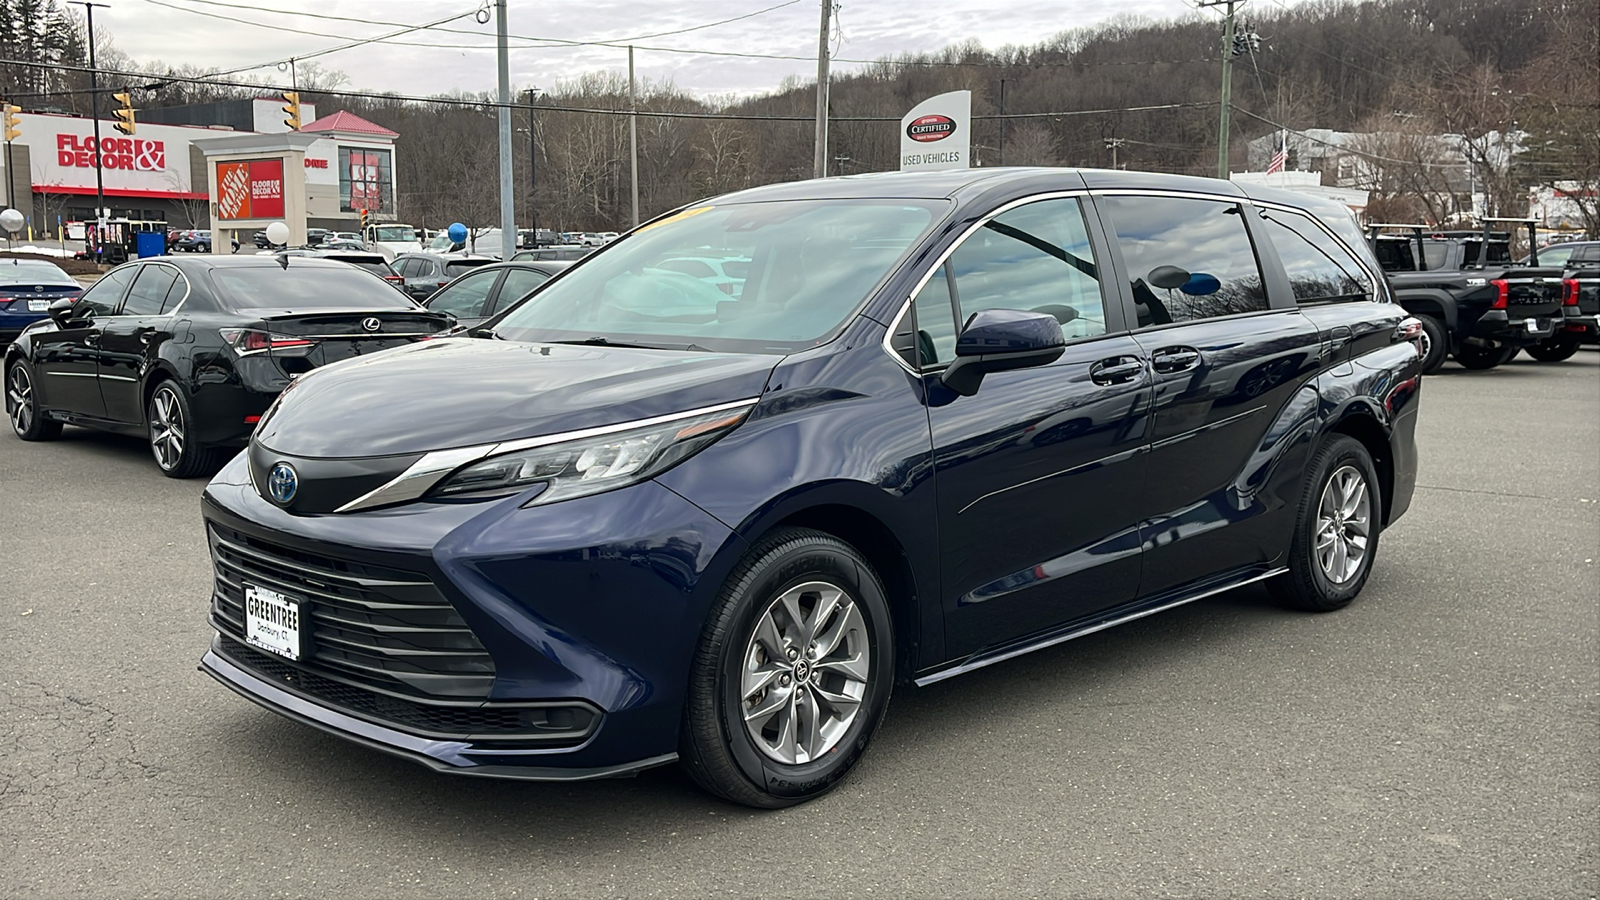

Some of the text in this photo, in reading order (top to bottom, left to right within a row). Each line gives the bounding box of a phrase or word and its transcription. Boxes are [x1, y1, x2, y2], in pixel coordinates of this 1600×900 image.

[911, 124, 950, 134] CERTIFIED
[56, 133, 133, 154] FLOOR
[57, 150, 134, 171] DECOR
[903, 151, 960, 166] USED VEHICLES
[220, 167, 234, 192] THE
[252, 180, 271, 188] FLOOR
[219, 163, 249, 219] HOME
[230, 182, 249, 219] DEPOT
[252, 187, 271, 195] DECOR
[248, 596, 297, 632] GREENTREE
